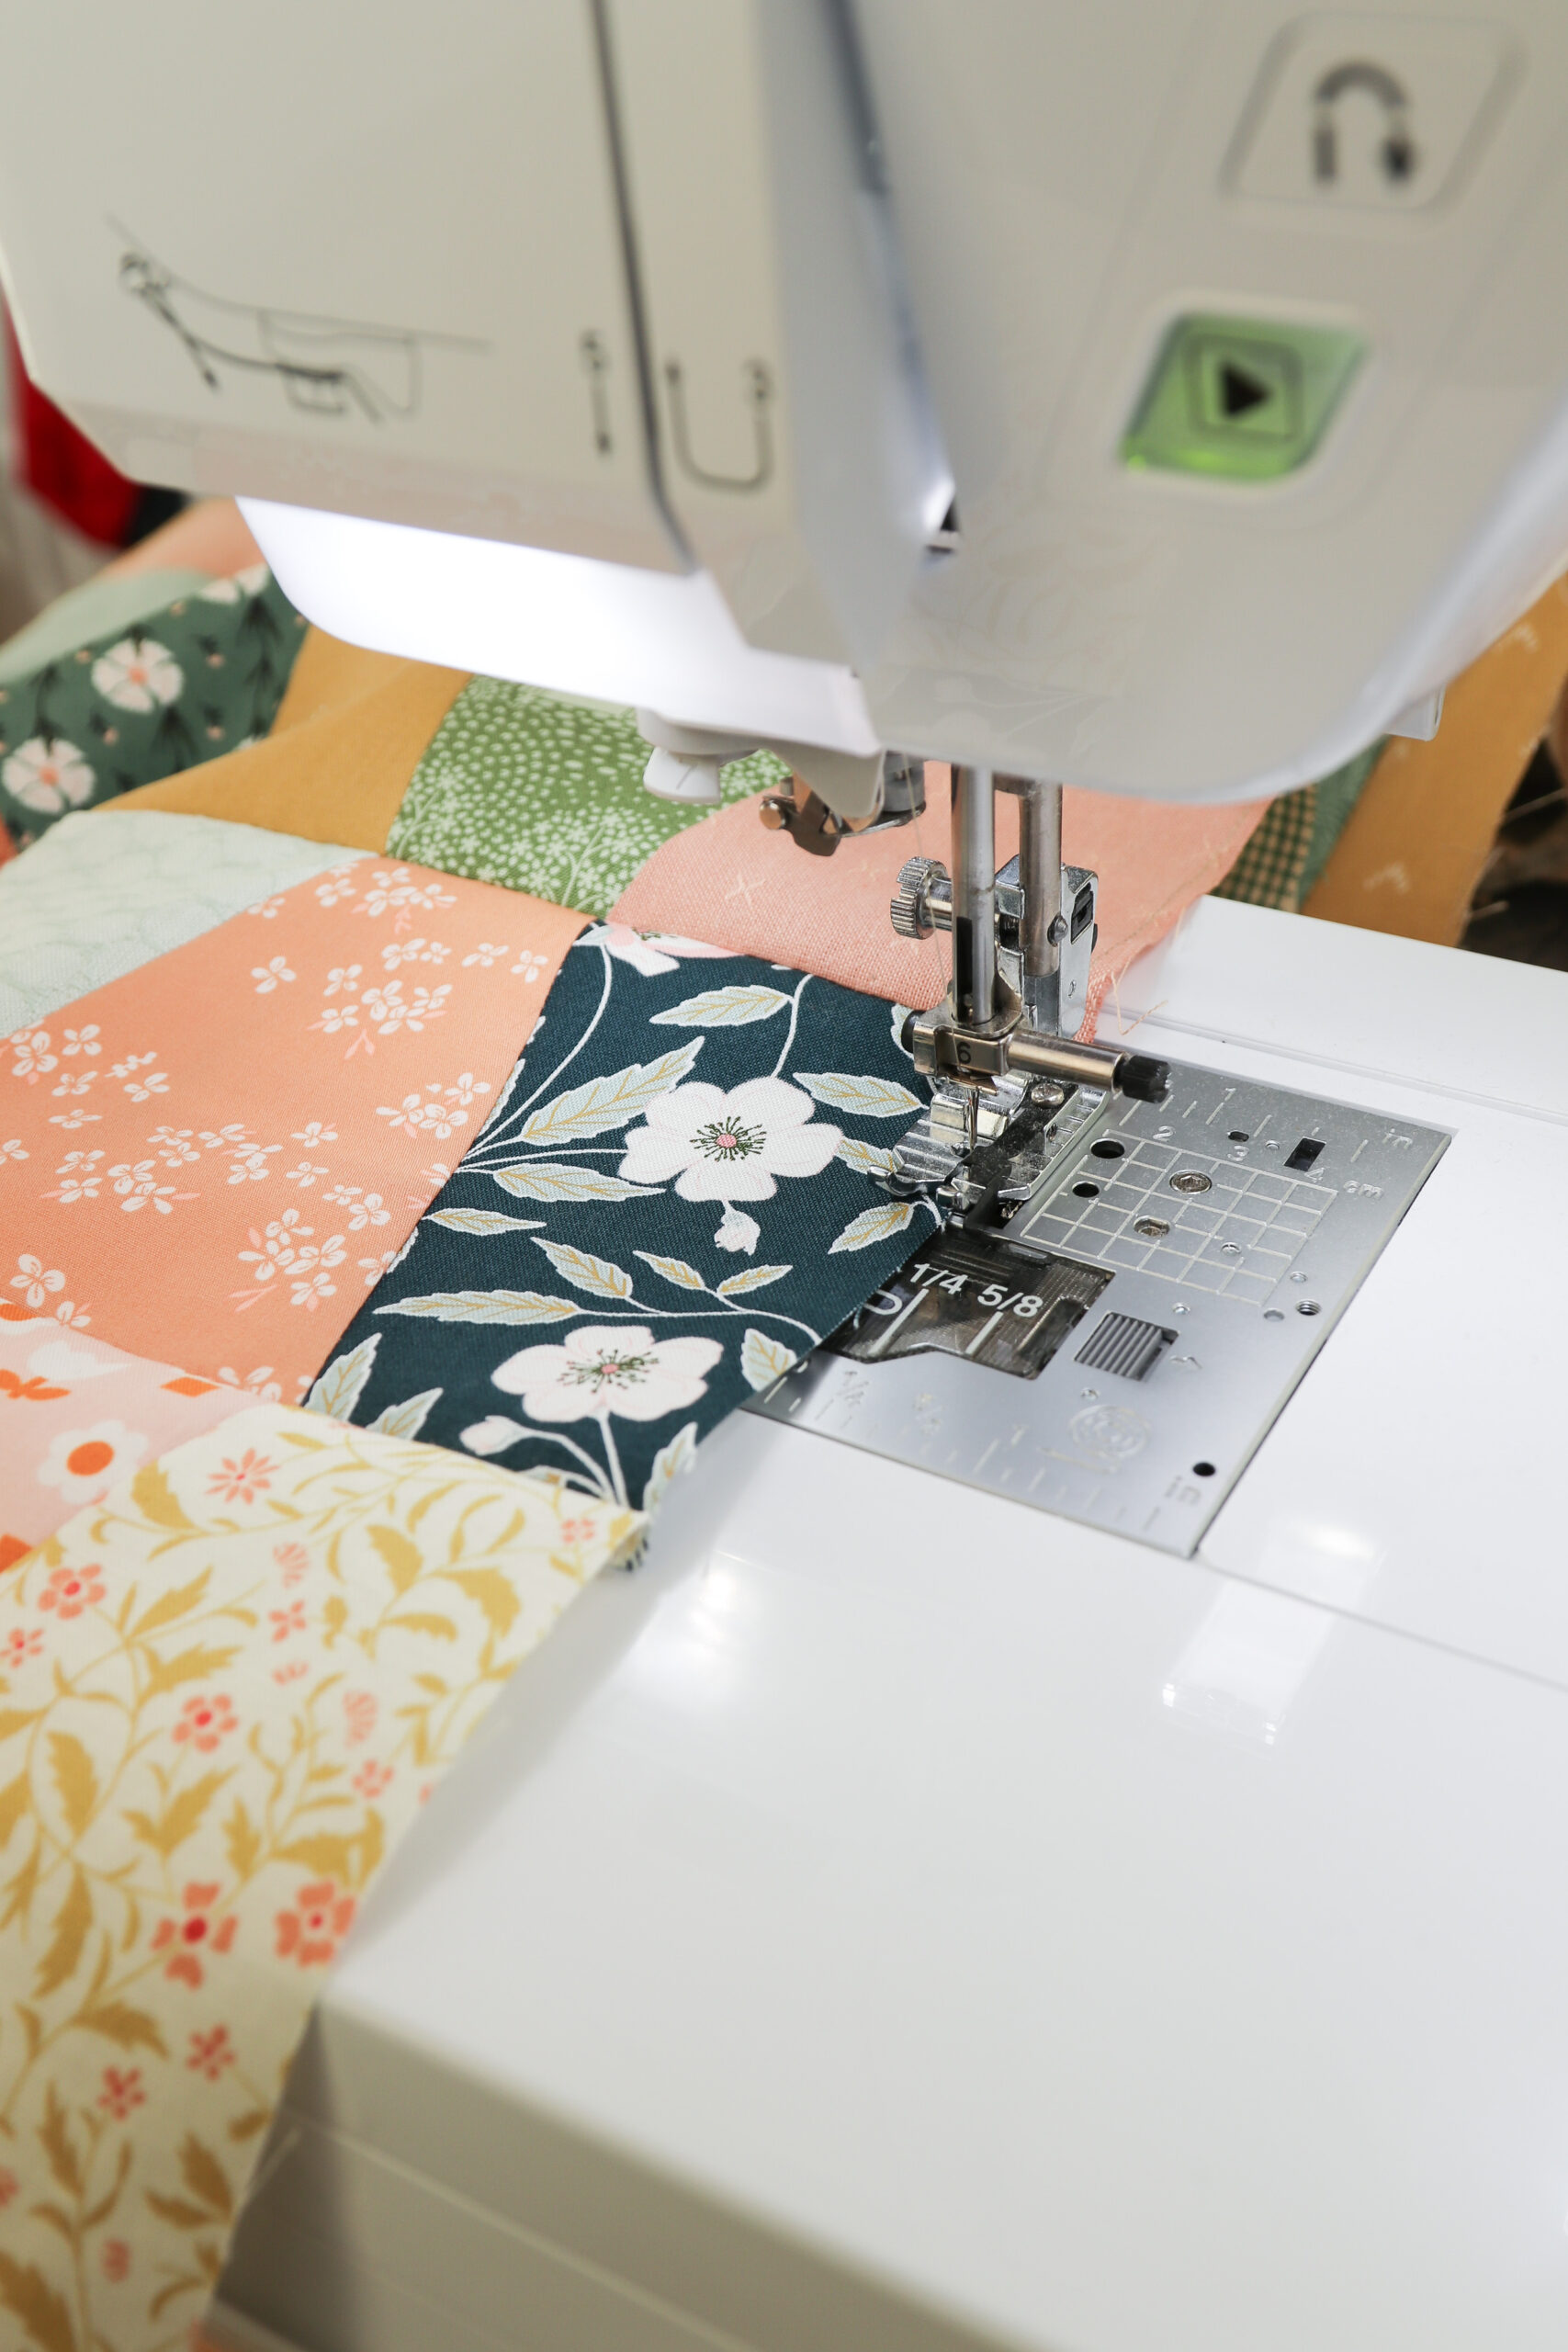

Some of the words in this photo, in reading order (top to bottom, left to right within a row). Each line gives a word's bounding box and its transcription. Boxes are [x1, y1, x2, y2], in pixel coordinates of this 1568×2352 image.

[956, 1041, 972, 1064] 6
[1153, 1125, 1177, 1142] 2
[1227, 1145, 1250, 1162] 3
[1304, 1167, 1326, 1183] 4
[1343, 1180, 1385, 1200] cm
[909, 1262, 969, 1295] 1/4
[977, 1283, 1043, 1318] 5/8
[1164, 1475, 1202, 1505] in
